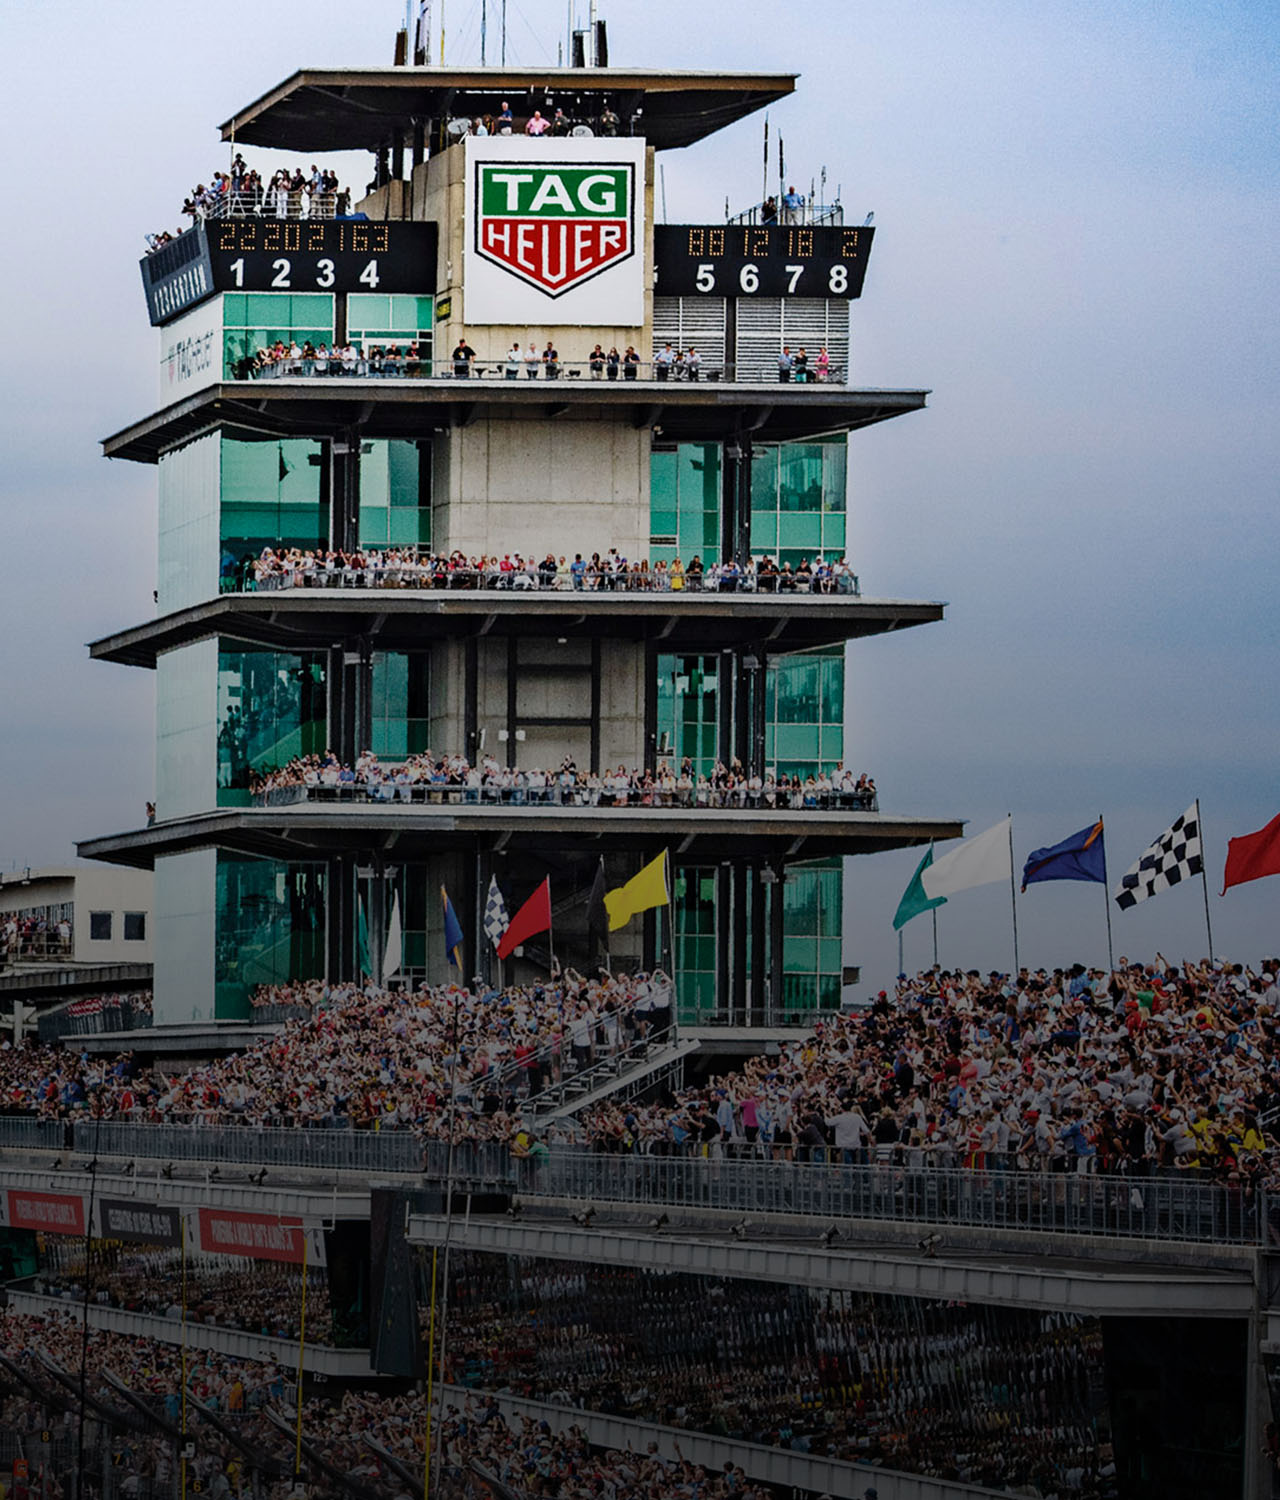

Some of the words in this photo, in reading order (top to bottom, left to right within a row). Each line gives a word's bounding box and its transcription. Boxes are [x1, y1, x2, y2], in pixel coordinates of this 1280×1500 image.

[492, 173, 617, 212] TAG
[221, 224, 255, 250] 22
[265, 224, 300, 250] 20
[689, 230, 724, 256] 88
[744, 230, 768, 256] 12
[789, 231, 812, 256] 18
[843, 232, 857, 257] 2
[488, 223, 622, 283] HEUER
[231, 259, 243, 286] 1
[272, 259, 290, 287] 2
[317, 259, 334, 287] 3
[360, 260, 379, 287] 4
[696, 264, 714, 292] 5
[740, 264, 758, 292] 6
[786, 266, 804, 292] 7
[829, 265, 847, 293] 8
[42, 1431, 50, 1441] 8
[113, 1454, 122, 1465] 7
[192, 1481, 201, 1492] 6
